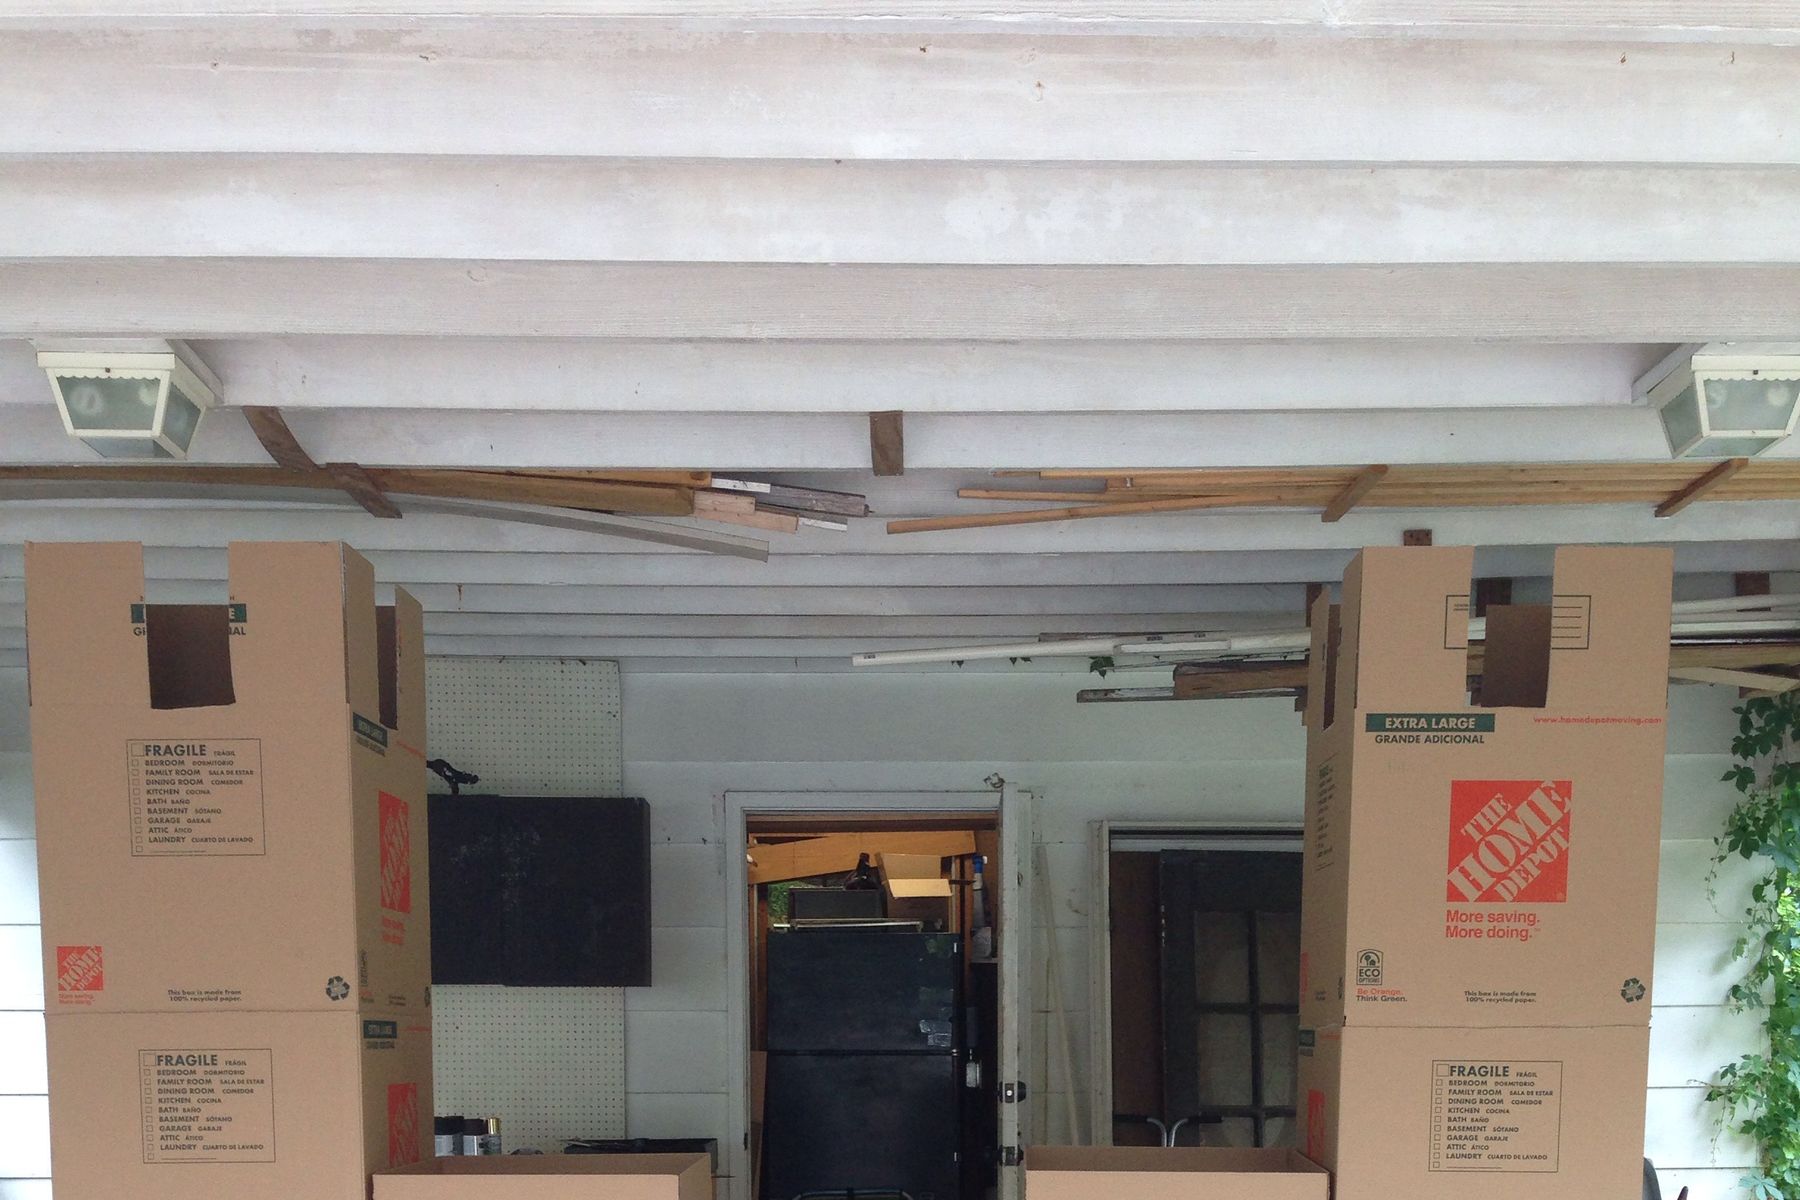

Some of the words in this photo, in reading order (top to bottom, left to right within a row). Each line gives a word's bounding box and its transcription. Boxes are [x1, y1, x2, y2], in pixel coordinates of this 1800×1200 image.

[1385, 718, 1427, 729] EXTRA
[1432, 718, 1475, 729] LARGE
[1375, 735, 1420, 744] GRANDE
[1424, 735, 1484, 744] ADICIONAL
[145, 745, 206, 756] FRAGILE
[1461, 792, 1513, 843] THE
[1447, 780, 1572, 901] HOME
[1494, 828, 1569, 902] DEPOT
[1447, 910, 1483, 922] More
[1488, 910, 1539, 926] saving.
[1446, 926, 1482, 938] More
[1487, 926, 1532, 941] doing.
[1359, 969, 1380, 977] ECO
[157, 1055, 217, 1066] FRAGILE
[1450, 1066, 1509, 1077] FRAGILE
